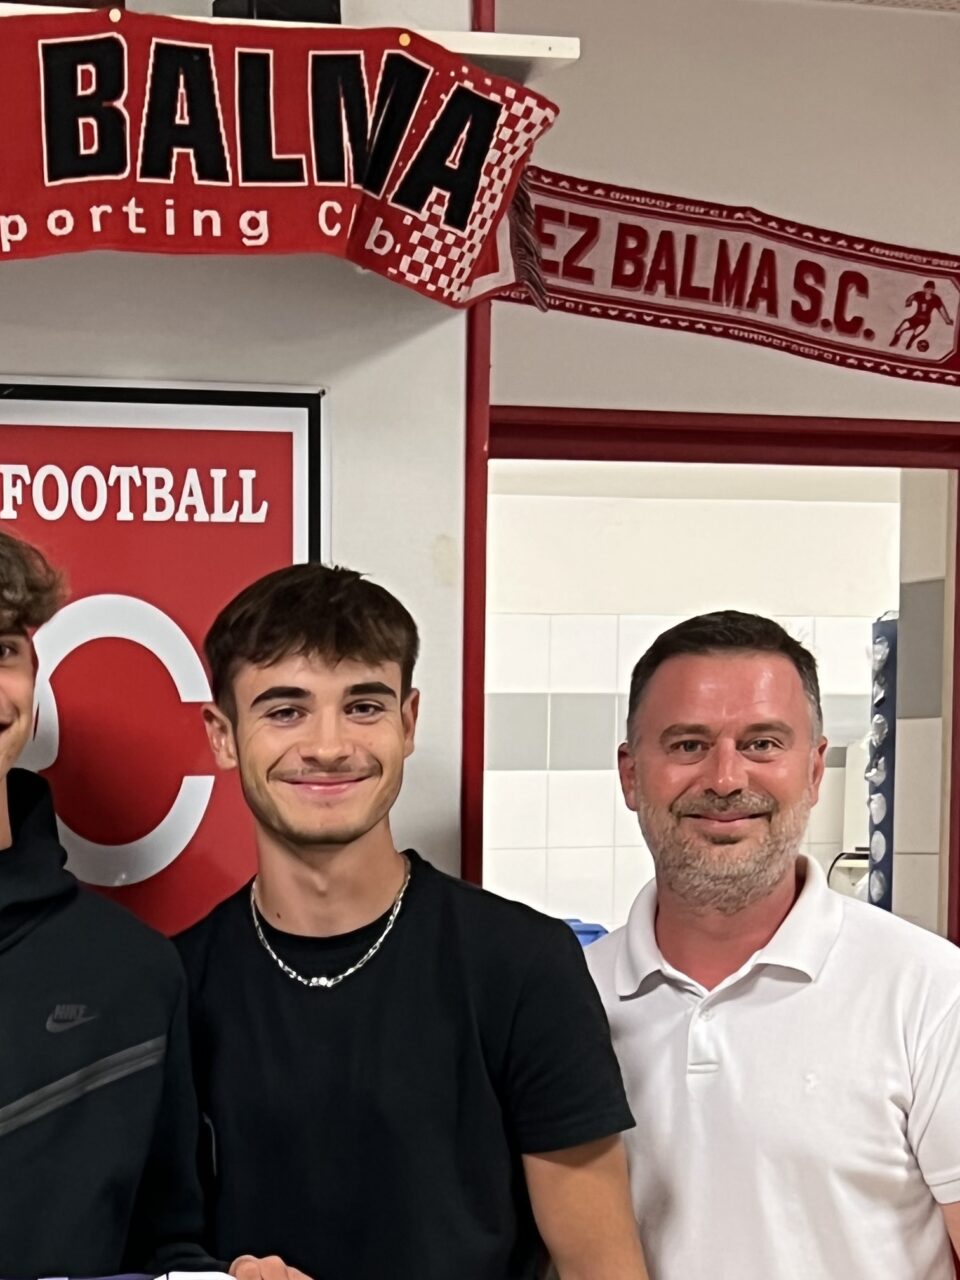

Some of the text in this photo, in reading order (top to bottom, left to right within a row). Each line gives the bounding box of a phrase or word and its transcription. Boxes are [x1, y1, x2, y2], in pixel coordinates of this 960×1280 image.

[38, 32, 504, 234] BALMA
[318, 200, 395, 256] Cb
[611, 222, 778, 319] BALMA
[791, 259, 875, 341] S.C.
